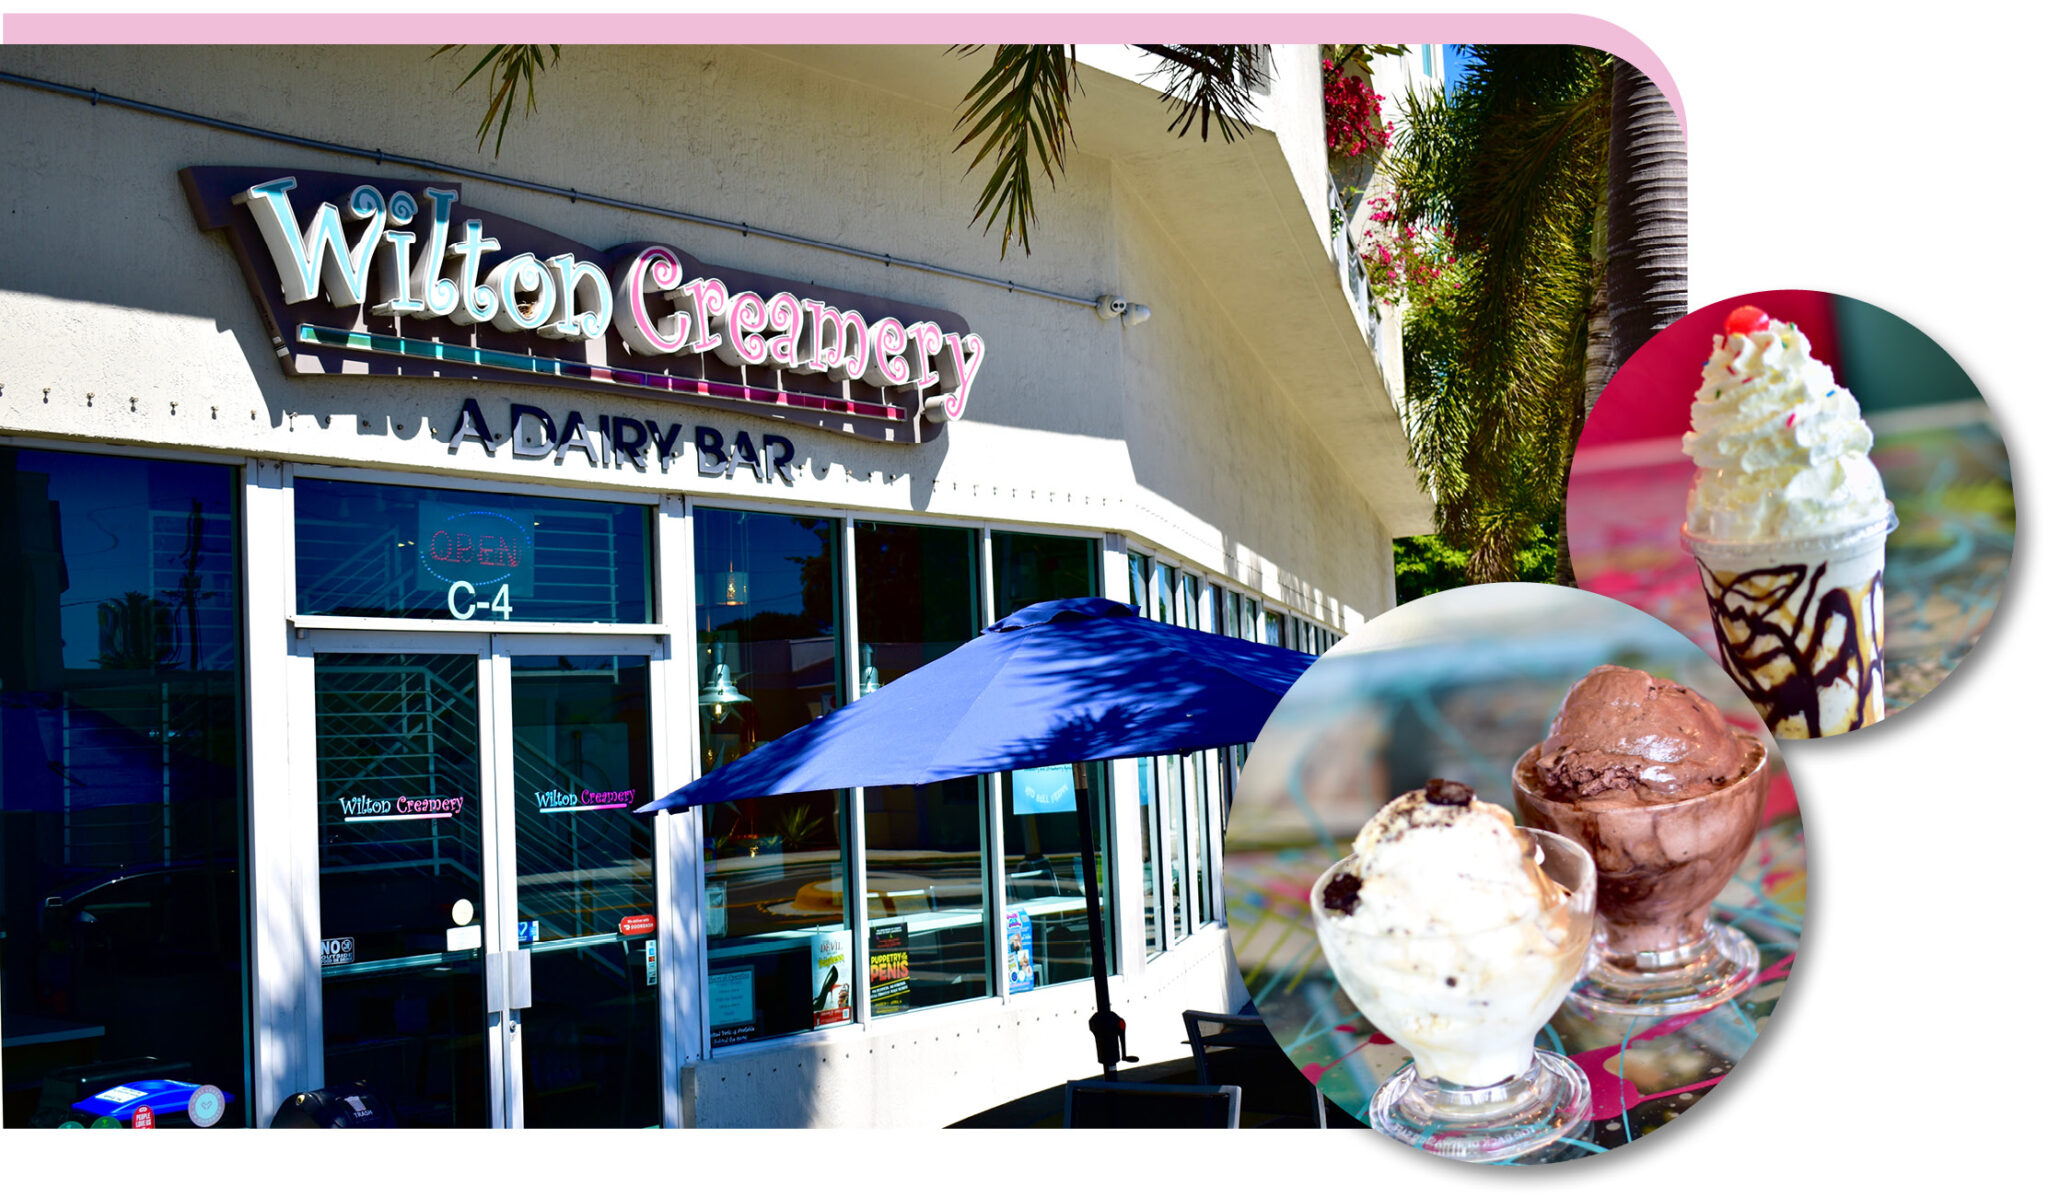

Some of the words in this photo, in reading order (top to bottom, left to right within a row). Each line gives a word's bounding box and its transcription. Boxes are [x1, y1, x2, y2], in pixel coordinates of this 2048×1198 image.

[246, 176, 613, 341] Wilton
[620, 246, 985, 422] Creamery
[448, 398, 495, 457] A
[511, 403, 683, 472] DAIRY
[695, 426, 795, 487] BAR
[429, 528, 522, 568] OPEN
[447, 580, 514, 621] C-4
[339, 795, 392, 815] Wilton
[396, 796, 464, 814] Creamery
[535, 788, 578, 807] Wilton
[581, 788, 636, 805] Creamery
[320, 940, 340, 955] NO
[870, 953, 901, 964] PUPPETRY
[870, 960, 909, 983] PENIS
